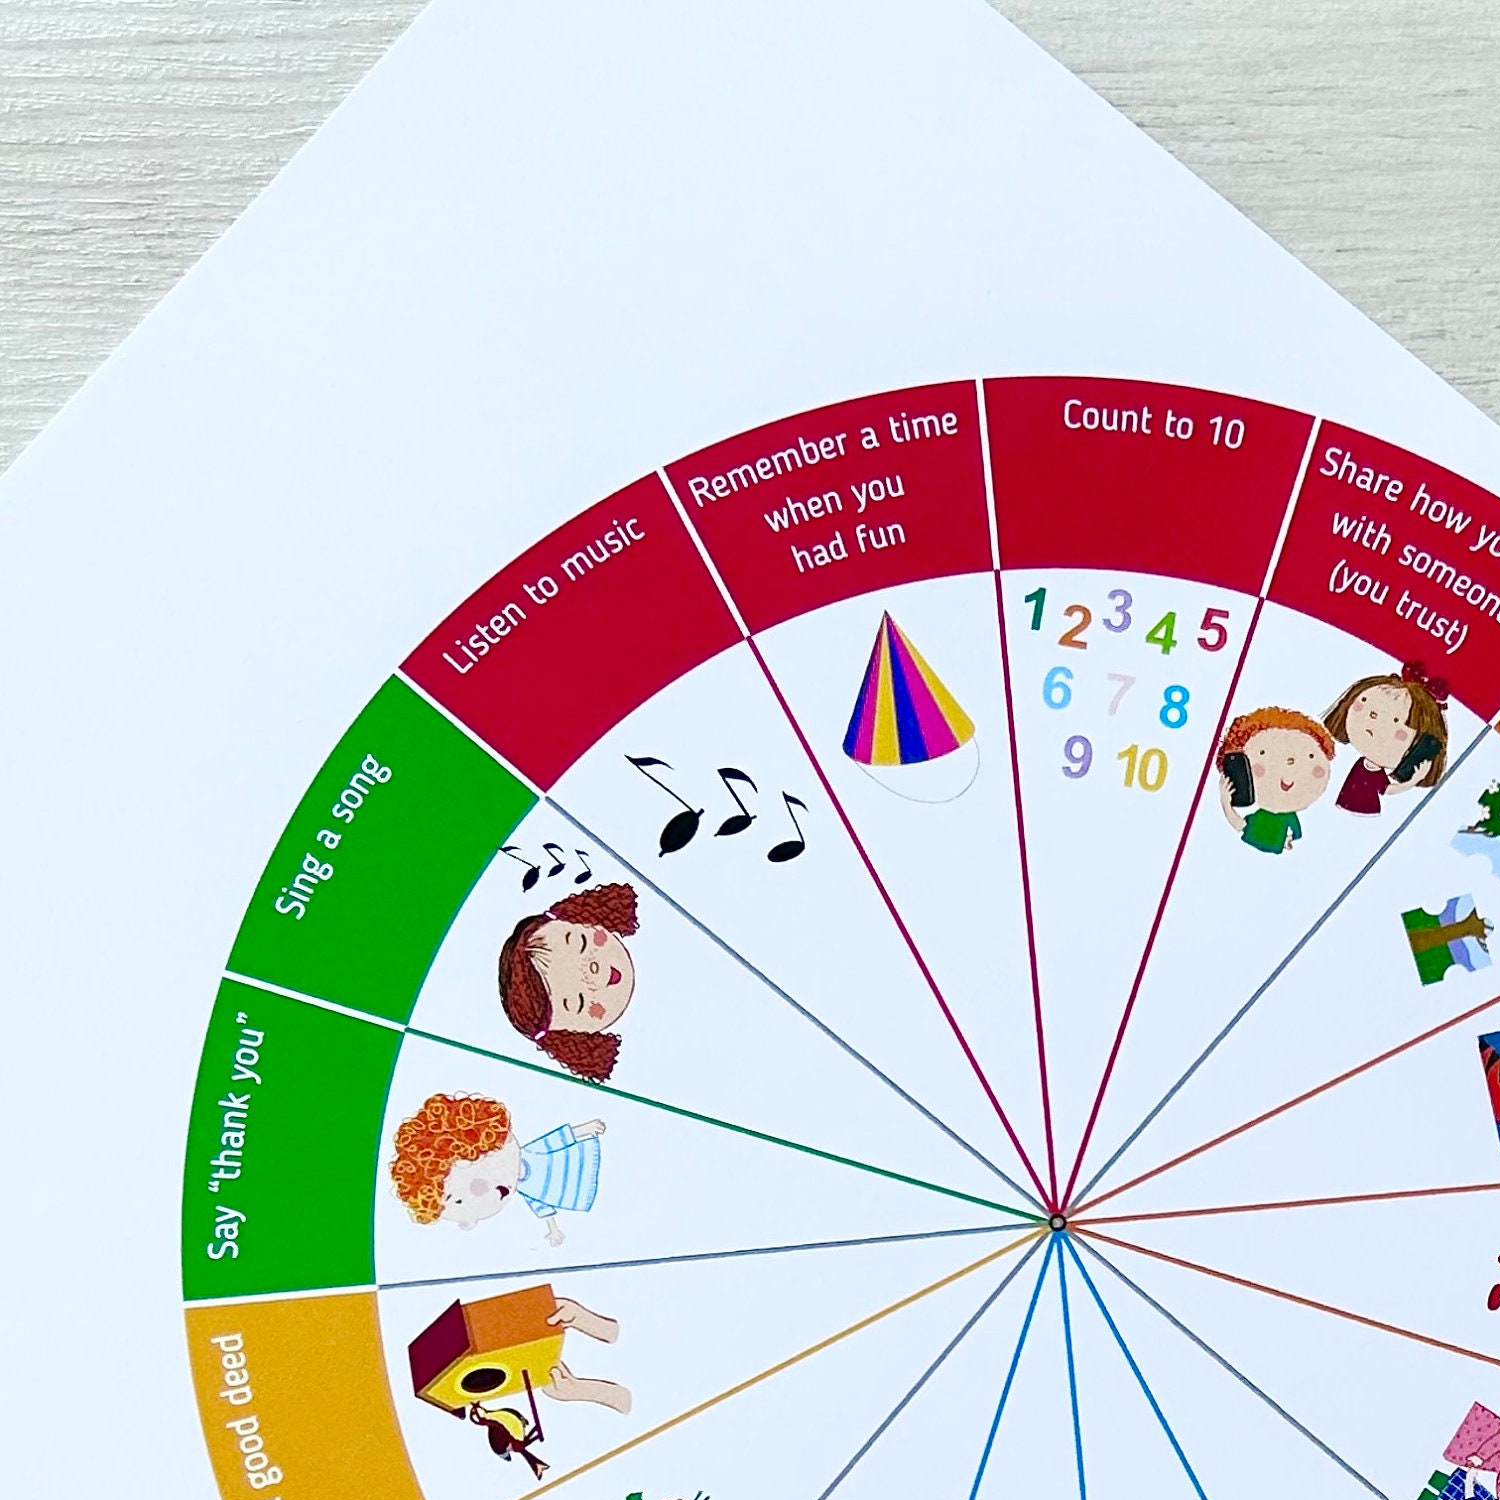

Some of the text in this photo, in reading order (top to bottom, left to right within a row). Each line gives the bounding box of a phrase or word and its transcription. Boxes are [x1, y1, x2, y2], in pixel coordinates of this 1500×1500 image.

[687, 412, 959, 507] Remember a time
[1062, 398, 1245, 449] Count to 10
[764, 473, 906, 533] when you
[1319, 446, 1405, 502] Share
[1410, 484, 1471, 534] how
[791, 522, 906, 573] had fun
[1331, 510, 1393, 555] with
[442, 515, 645, 675] Listen to music
[1024, 587, 1229, 655] 1 2 3 4 5
[1327, 559, 1469, 655] (you trust)
[1042, 665, 1190, 729] 6 7 8
[1061, 735, 1169, 793] 9 10
[274, 754, 392, 921] Sing a song
[206, 1011, 266, 1260] Say “thank you”
[210, 1332, 253, 1408] deed
[225, 1416, 284, 1490] good
